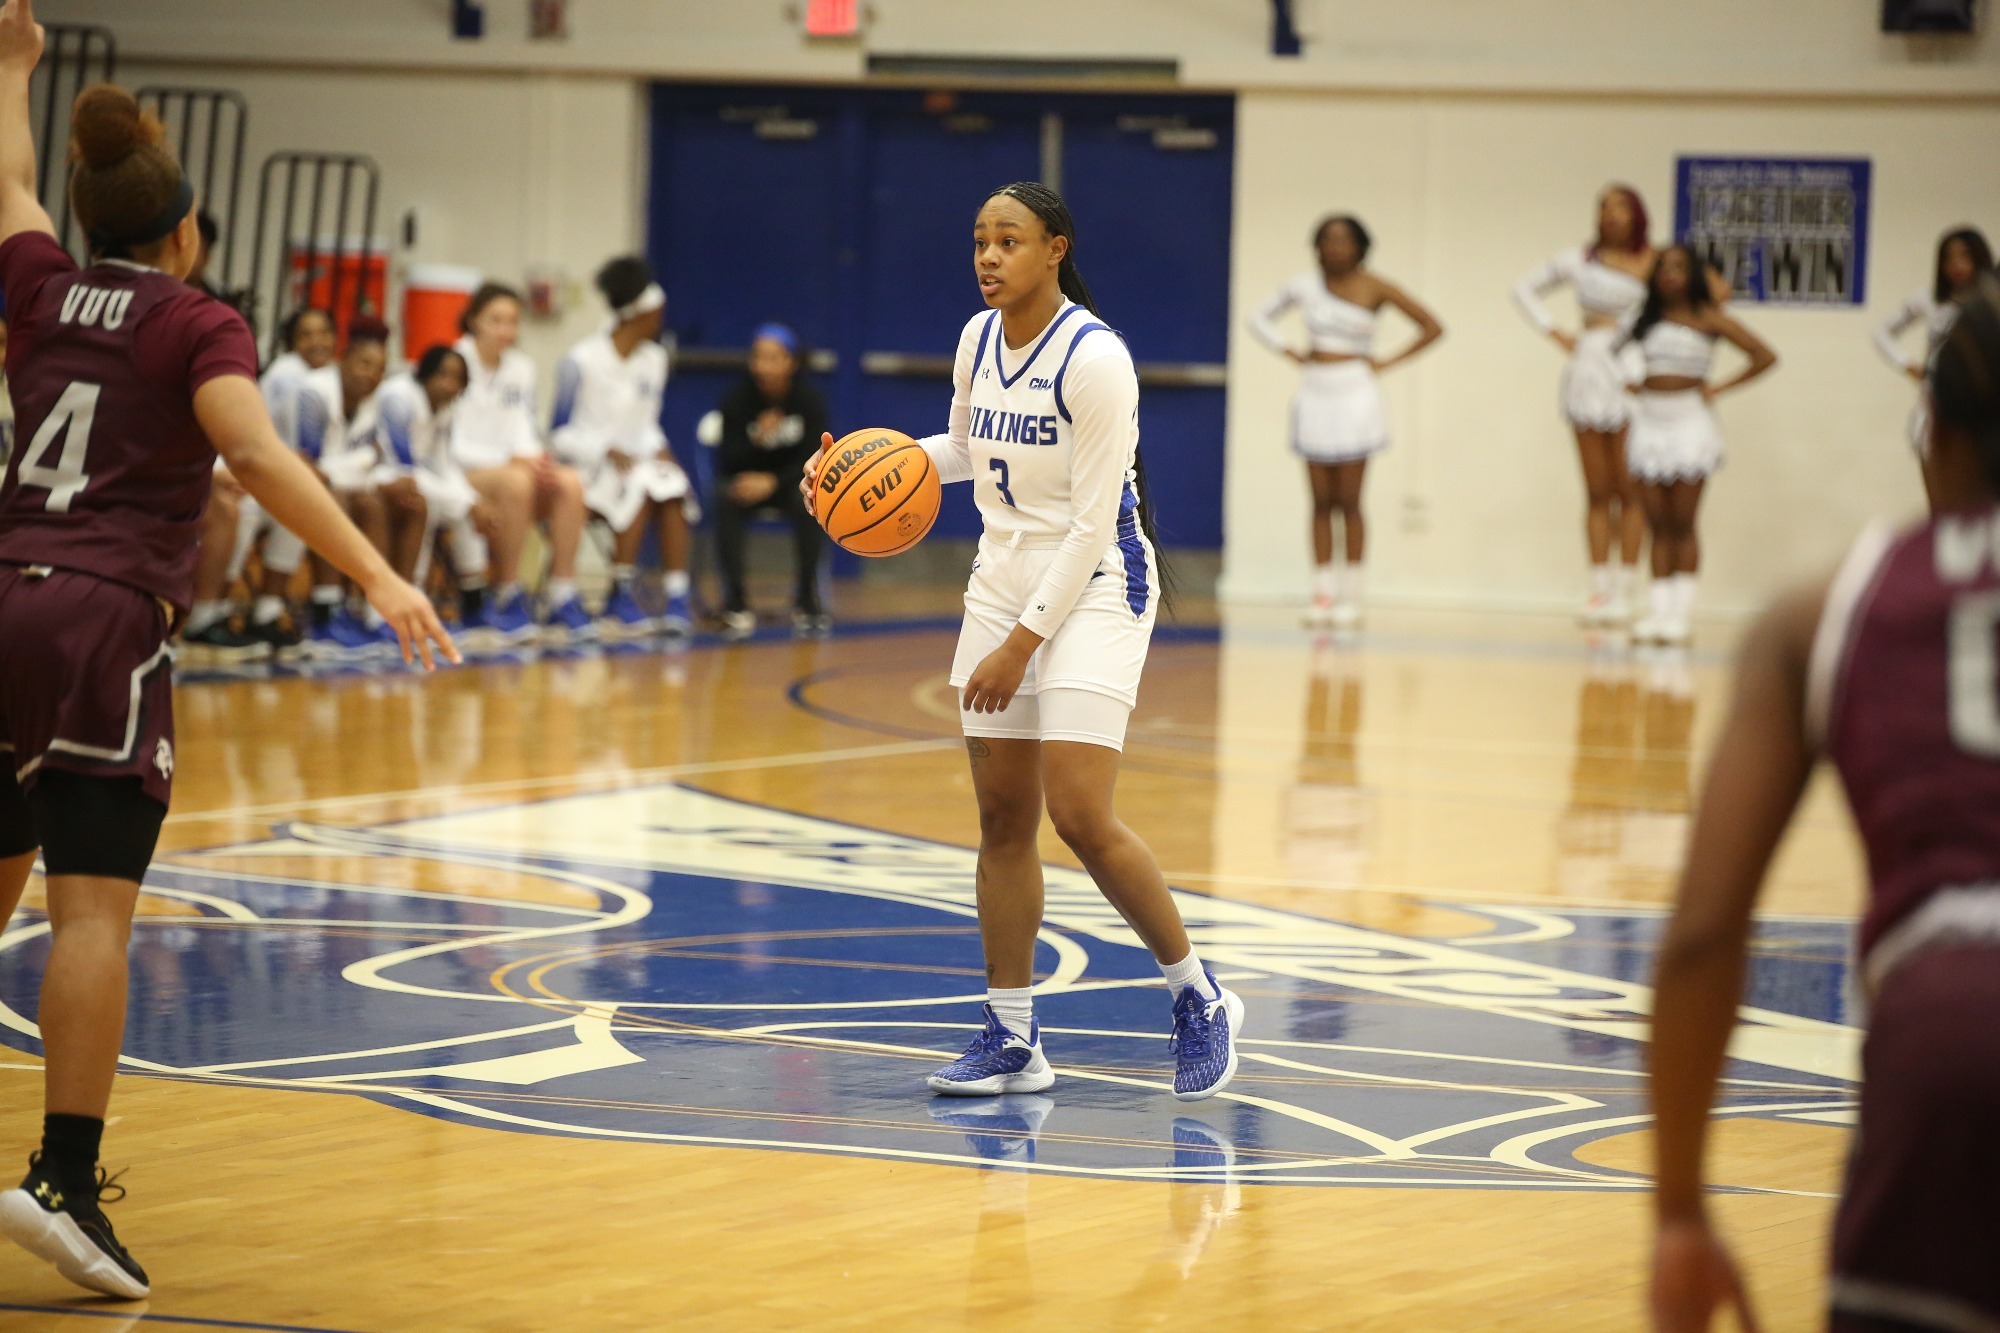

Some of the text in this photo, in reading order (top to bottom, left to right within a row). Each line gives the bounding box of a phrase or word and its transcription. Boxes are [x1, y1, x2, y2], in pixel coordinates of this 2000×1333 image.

[59, 283, 135, 330] VUU
[18, 380, 101, 513] 4
[820, 436, 893, 494] Wilson
[897, 457, 909, 471] NXT
[989, 456, 1017, 508] 3
